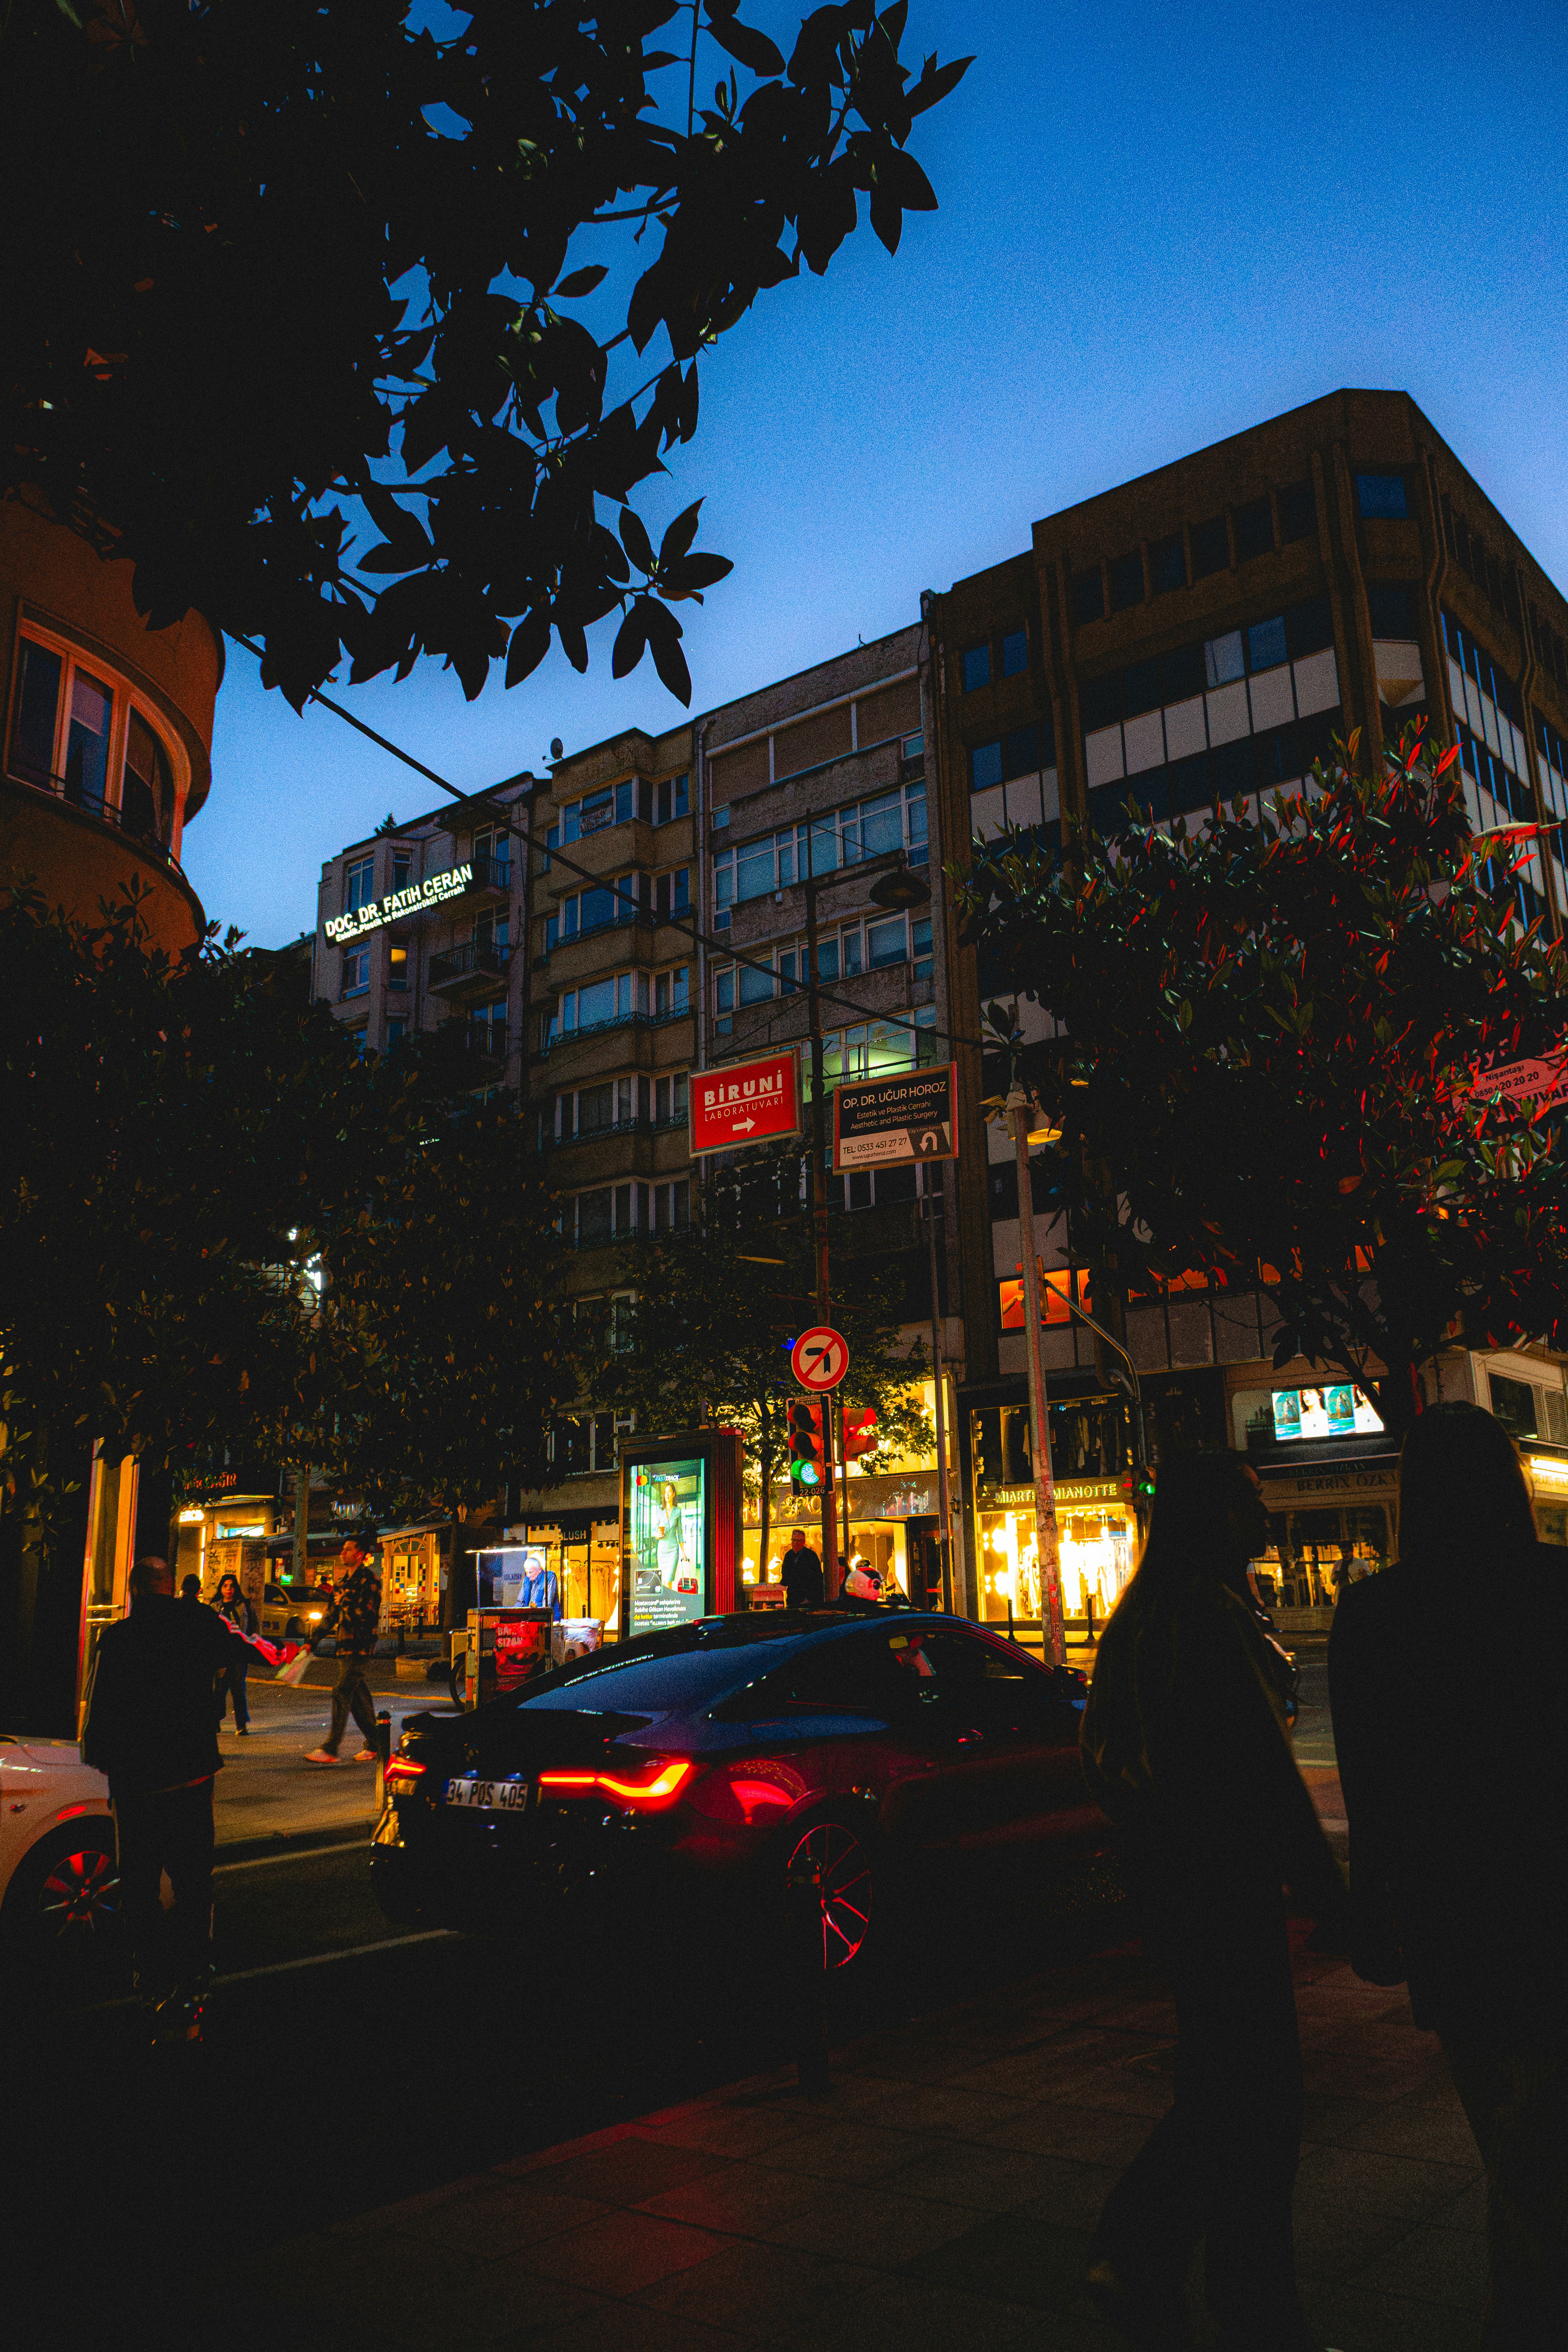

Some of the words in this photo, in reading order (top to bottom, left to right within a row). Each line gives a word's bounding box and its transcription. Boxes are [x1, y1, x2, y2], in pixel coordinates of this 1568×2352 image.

[325, 913, 358, 936] DOÇ.
[358, 903, 382, 923] DR.
[383, 884, 421, 913] FATİH
[423, 864, 473, 897] CERAN
[843, 1098, 859, 1109] OP.
[861, 1094, 877, 1106] DR.
[879, 1089, 907, 1102] UĞUR
[909, 1082, 946, 1097] HOROZ
[1475, 1087, 1493, 1098] 0850
[1514, 1076, 1525, 1086] 20
[1527, 1071, 1539, 1082] 20
[705, 1096, 783, 1122] LABORATUVARI
[851, 1120, 878, 1130] Aesthetic
[893, 1114, 912, 1123] Plastic
[913, 1110, 938, 1119] Surgery
[857, 1111, 877, 1119] Estetik
[887, 1105, 907, 1114] Plastik
[908, 1100, 931, 1110] Cerrahi
[852, 1149, 897, 1160] www.ugurhoroz.com
[857, 1142, 874, 1152] 0533
[875, 1140, 887, 1149] 451
[888, 1139, 897, 1147] 27
[899, 1137, 907, 1145] 27
[800, 1486, 824, 1496] 22-026
[447, 1781, 462, 1803] 34
[470, 1782, 494, 1805] POS
[500, 1784, 525, 1808] 405
